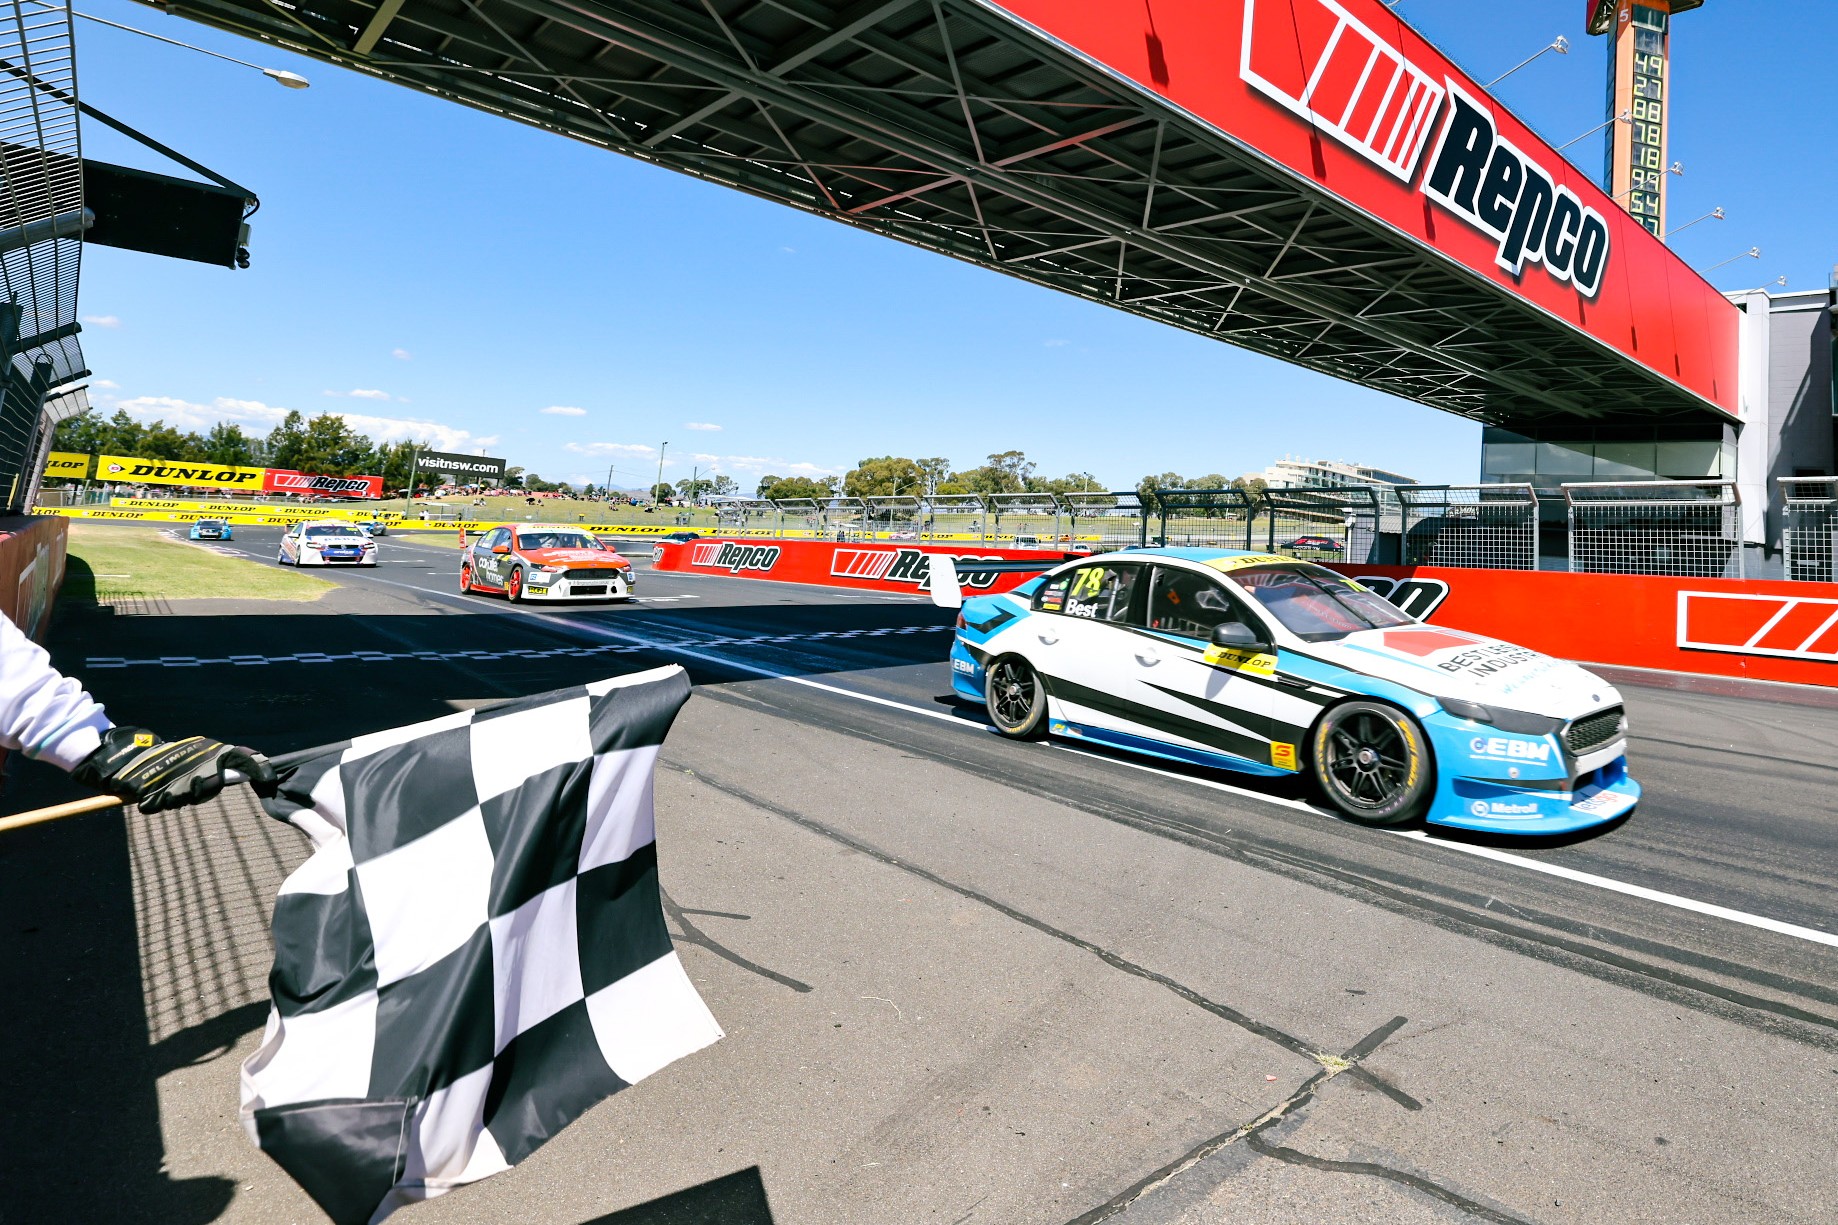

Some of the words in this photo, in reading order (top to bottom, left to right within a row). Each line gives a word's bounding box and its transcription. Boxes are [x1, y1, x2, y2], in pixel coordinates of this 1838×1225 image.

[1635, 53, 1662, 77] 49
[1634, 76, 1661, 99] 27
[1633, 98, 1661, 123] 88
[1635, 122, 1660, 146] 78
[1641, 147, 1660, 169] 18
[1424, 82, 1608, 295] Repco
[1632, 169, 1660, 192] 99
[1630, 191, 1659, 215] 54
[128, 464, 257, 483] DUNLOP
[418, 456, 499, 474] visitnsw.com
[312, 475, 370, 492] Repco
[129, 500, 179, 508] DUNLOP
[717, 542, 781, 573] Repco
[1071, 567, 1105, 597] 78
[1065, 598, 1098, 618] Best
[954, 658, 975, 675] EBM
[1218, 652, 1271, 668] DUNLOP
